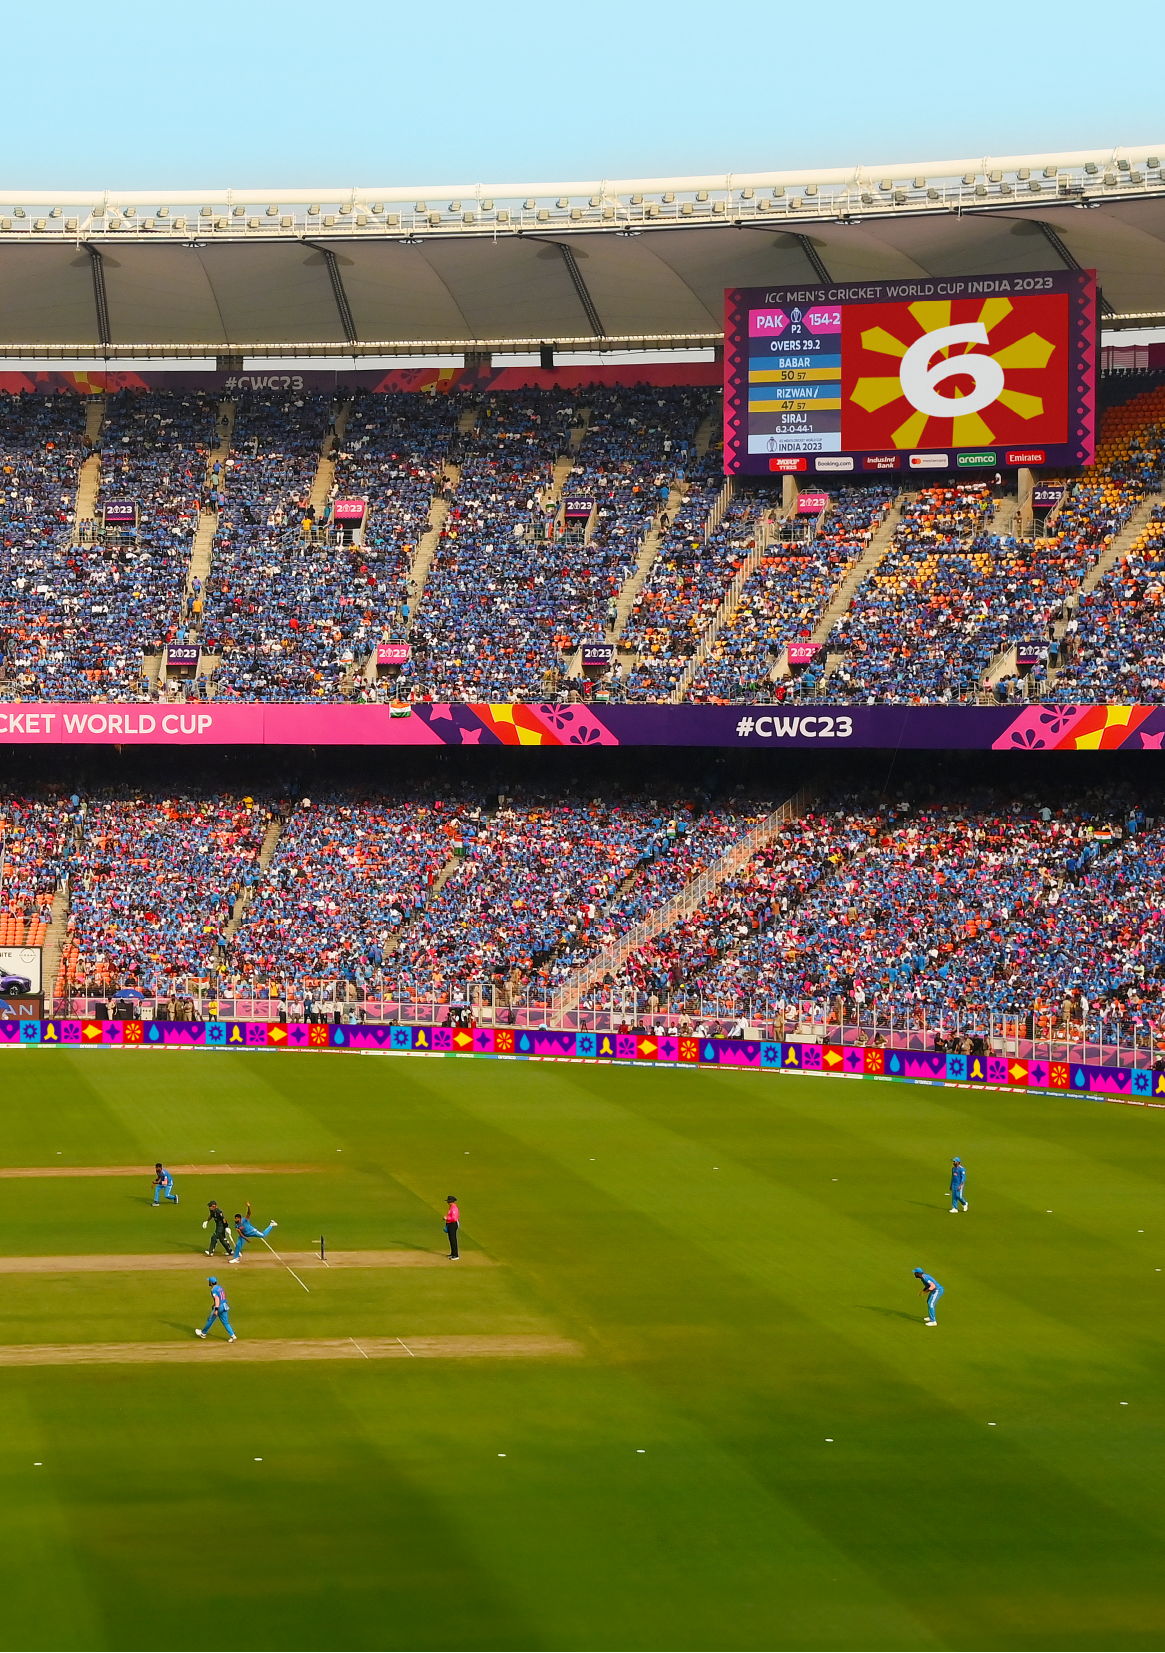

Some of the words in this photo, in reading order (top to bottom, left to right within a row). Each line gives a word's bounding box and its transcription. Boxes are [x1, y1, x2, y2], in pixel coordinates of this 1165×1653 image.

[765, 293, 784, 303] ICC
[786, 290, 825, 302] MEN'S
[828, 287, 882, 300] CRICKET
[886, 284, 934, 297] WORLD
[937, 282, 964, 294] CUP
[968, 280, 1011, 293] INDIA
[1014, 277, 1053, 291] 2023
[756, 315, 783, 329] PAK
[809, 313, 841, 326] 154-2
[791, 325, 802, 334] P2
[770, 340, 801, 351] OVERS
[802, 340, 821, 350] 29.2
[779, 357, 810, 368] BABAR
[781, 370, 794, 380] 50
[797, 372, 806, 380] 57
[899, 322, 1005, 417] 6
[225, 375, 304, 390] #CWC23
[776, 388, 812, 398] RIZWAN
[781, 401, 794, 410] 47
[797, 402, 806, 410] 57
[781, 413, 807, 424] SIRAJ
[775, 425, 813, 433] 6.2-0-44-1
[779, 443, 801, 451] INDIA
[803, 443, 822, 451] 2023
[1009, 454, 1042, 462] Emirates
[63, 714, 156, 734] WORLD
[161, 714, 213, 734] CUP
[736, 716, 853, 737] #CWC23
